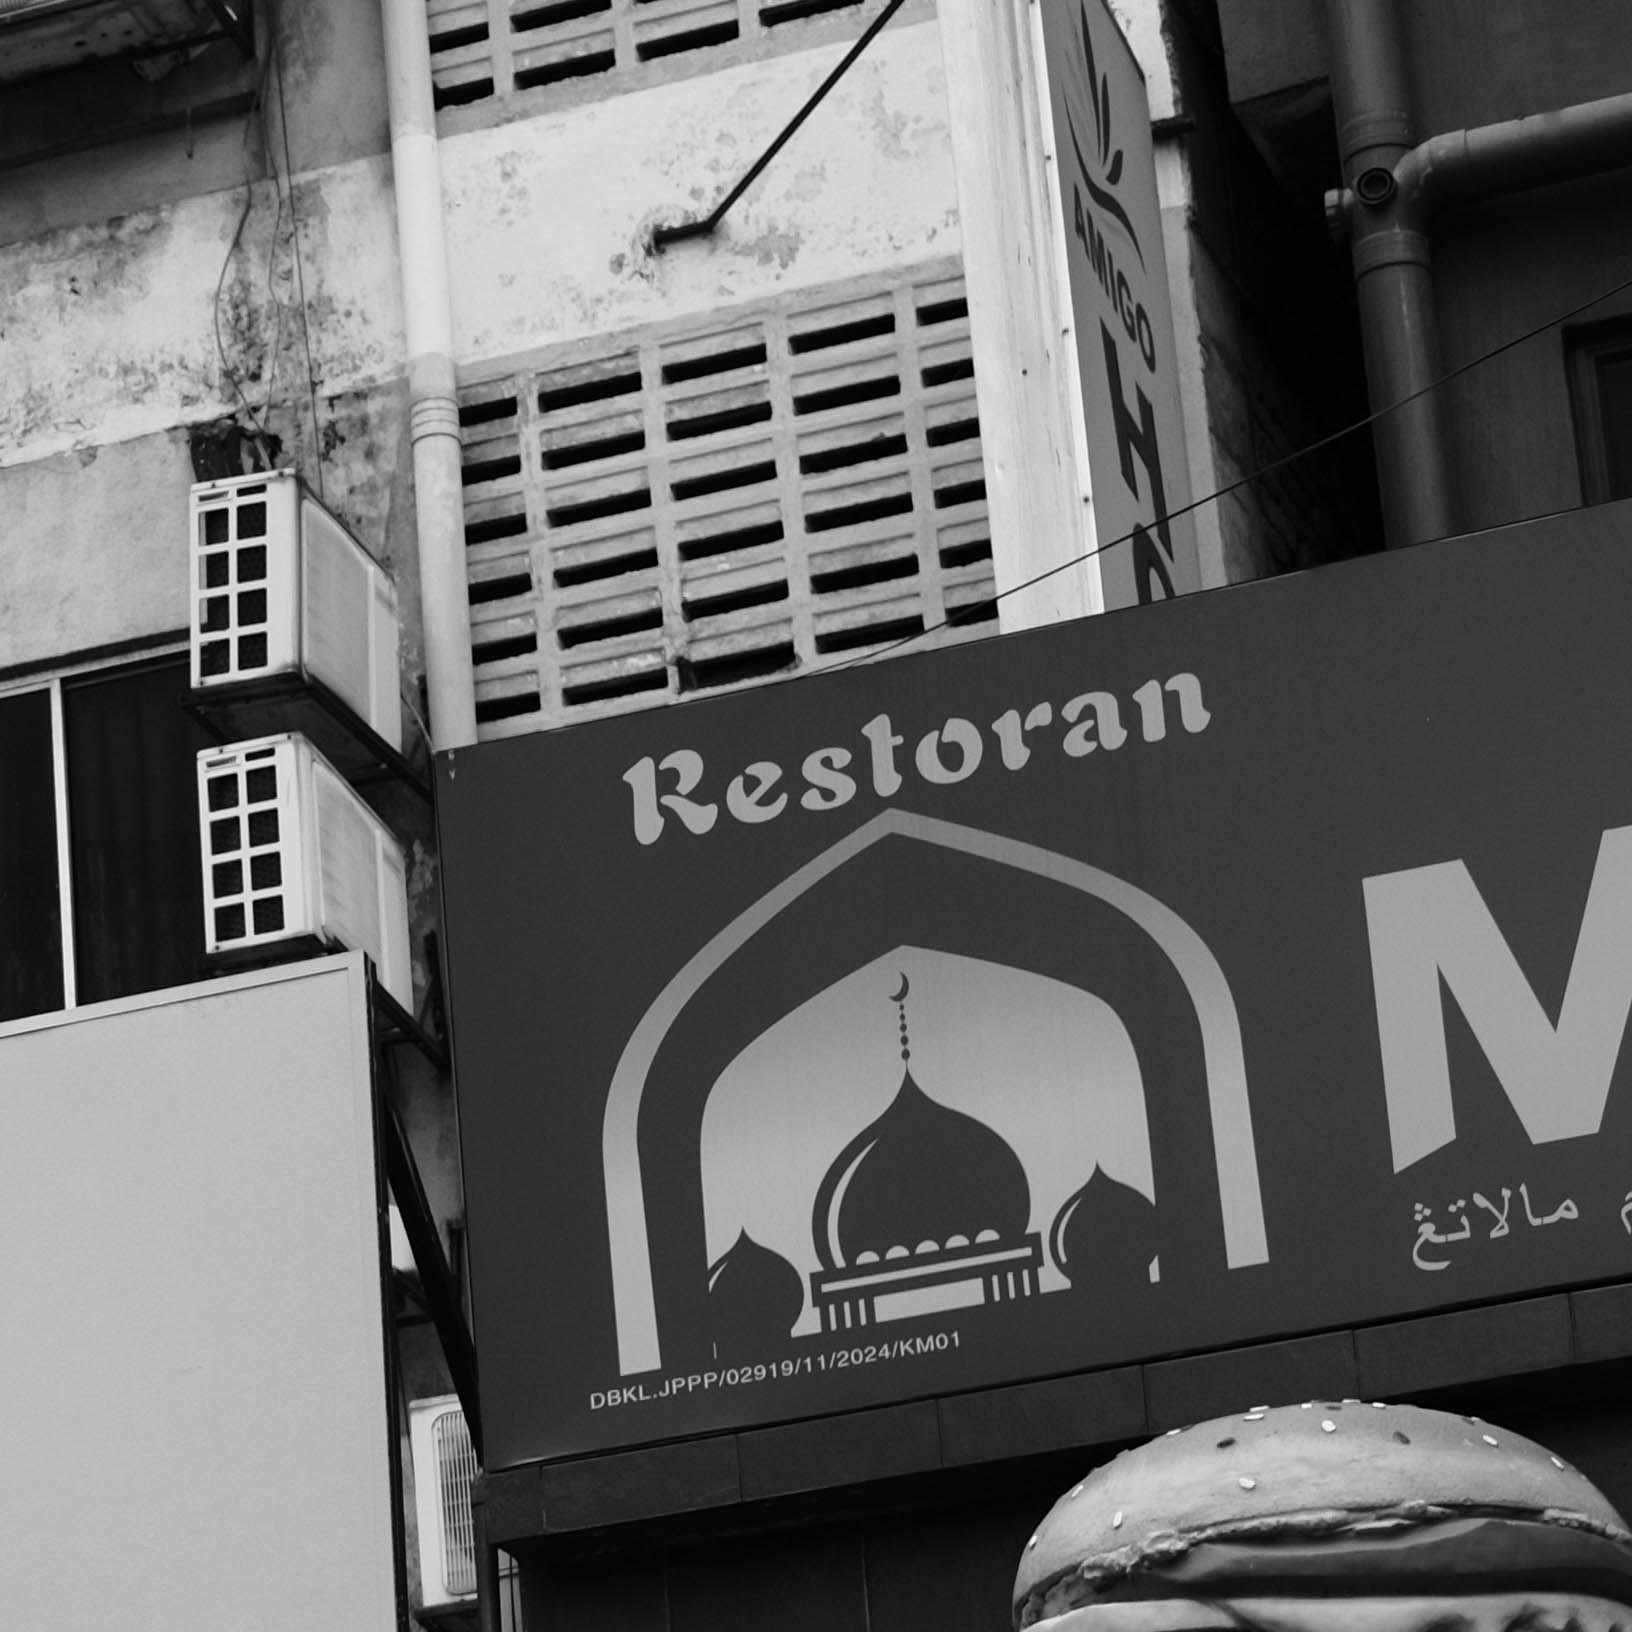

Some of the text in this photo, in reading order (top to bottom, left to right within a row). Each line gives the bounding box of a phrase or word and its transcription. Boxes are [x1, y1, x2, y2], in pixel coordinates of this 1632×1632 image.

[1073, 183, 1157, 375] AMIGO
[622, 672, 1211, 846] Restoran
[589, 1330, 961, 1411] DBKL.JPPP/02919/11/2024/KM01
